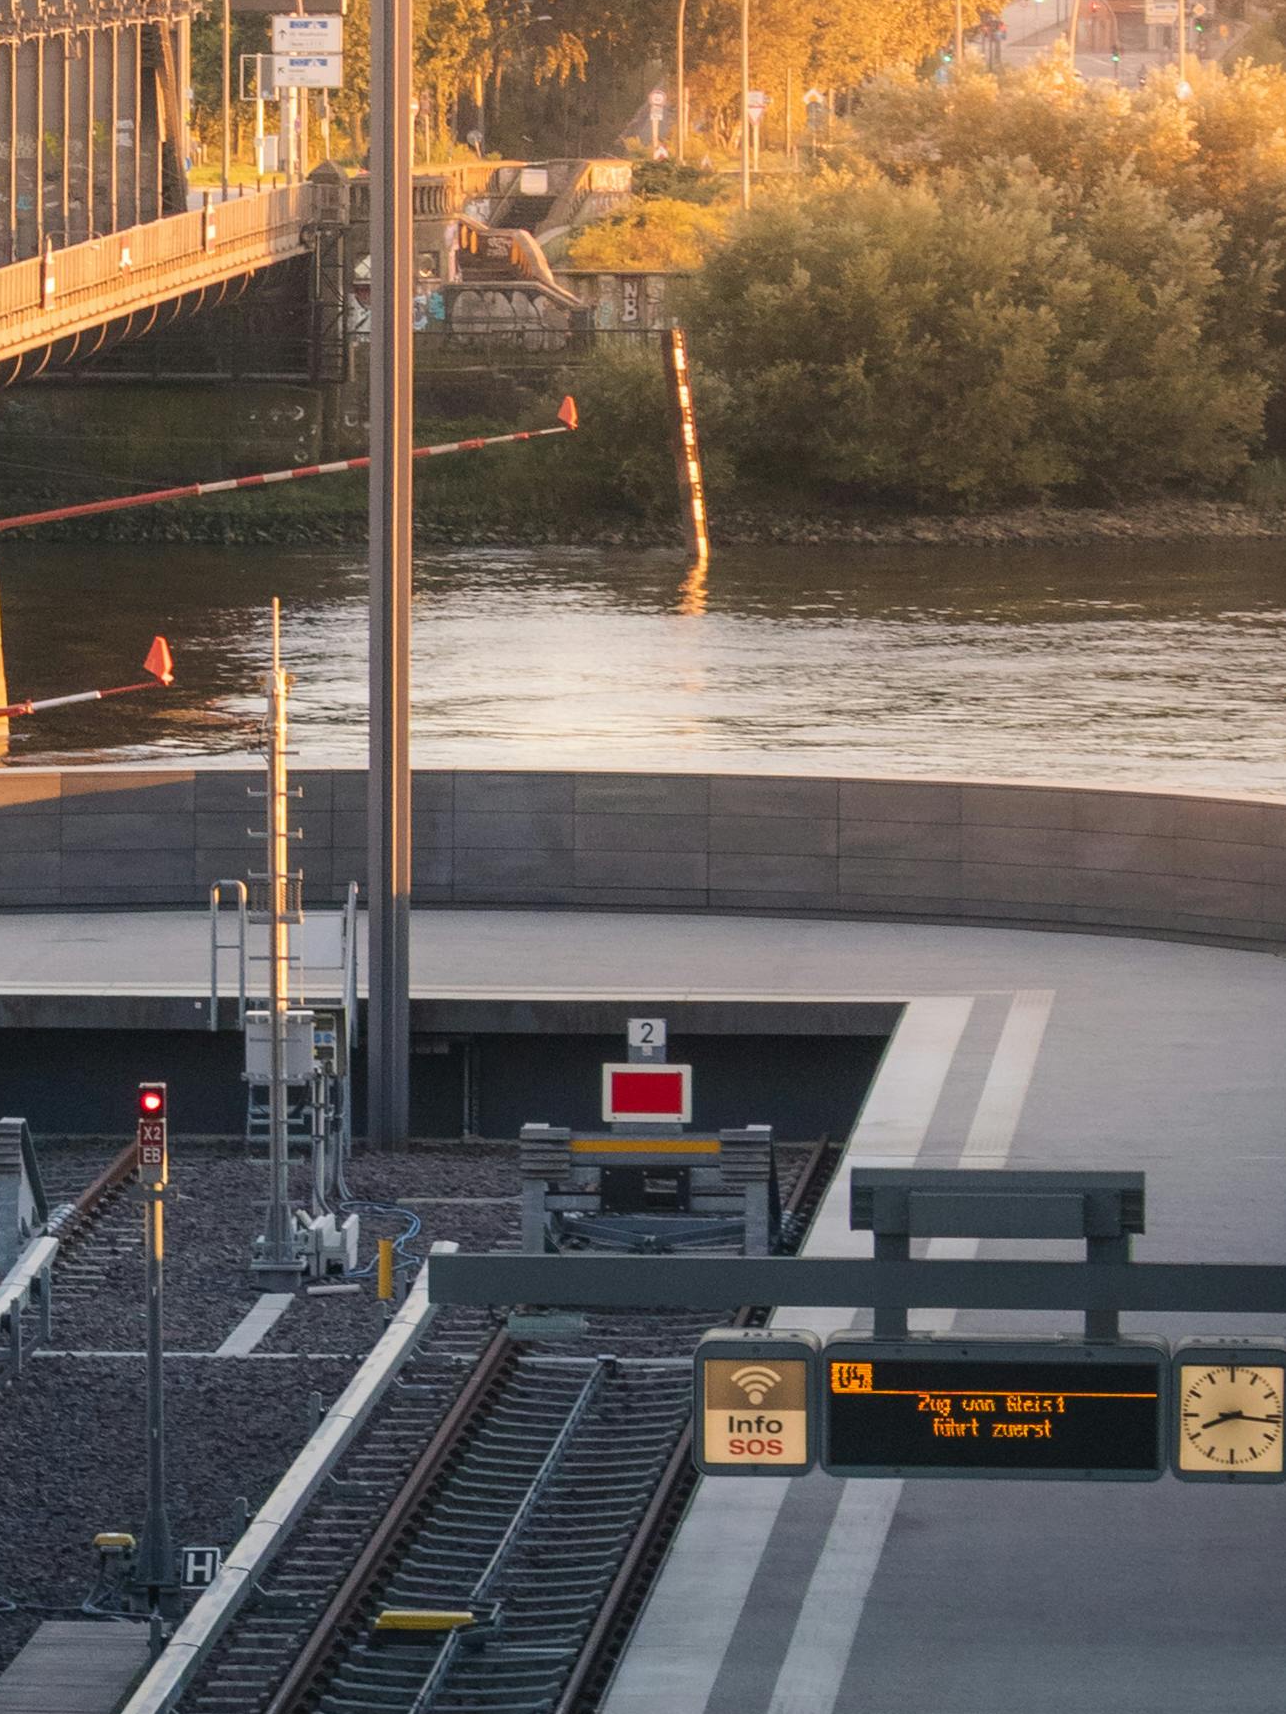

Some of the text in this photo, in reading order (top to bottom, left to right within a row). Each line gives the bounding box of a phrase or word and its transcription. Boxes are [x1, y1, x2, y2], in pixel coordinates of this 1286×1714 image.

[641, 1023, 654, 1043] 2
[143, 1126, 161, 1141] X2
[143, 1148, 161, 1164] EB
[729, 1416, 783, 1434] Info
[729, 1439, 783, 1455] SOS
[186, 1552, 213, 1583] H
